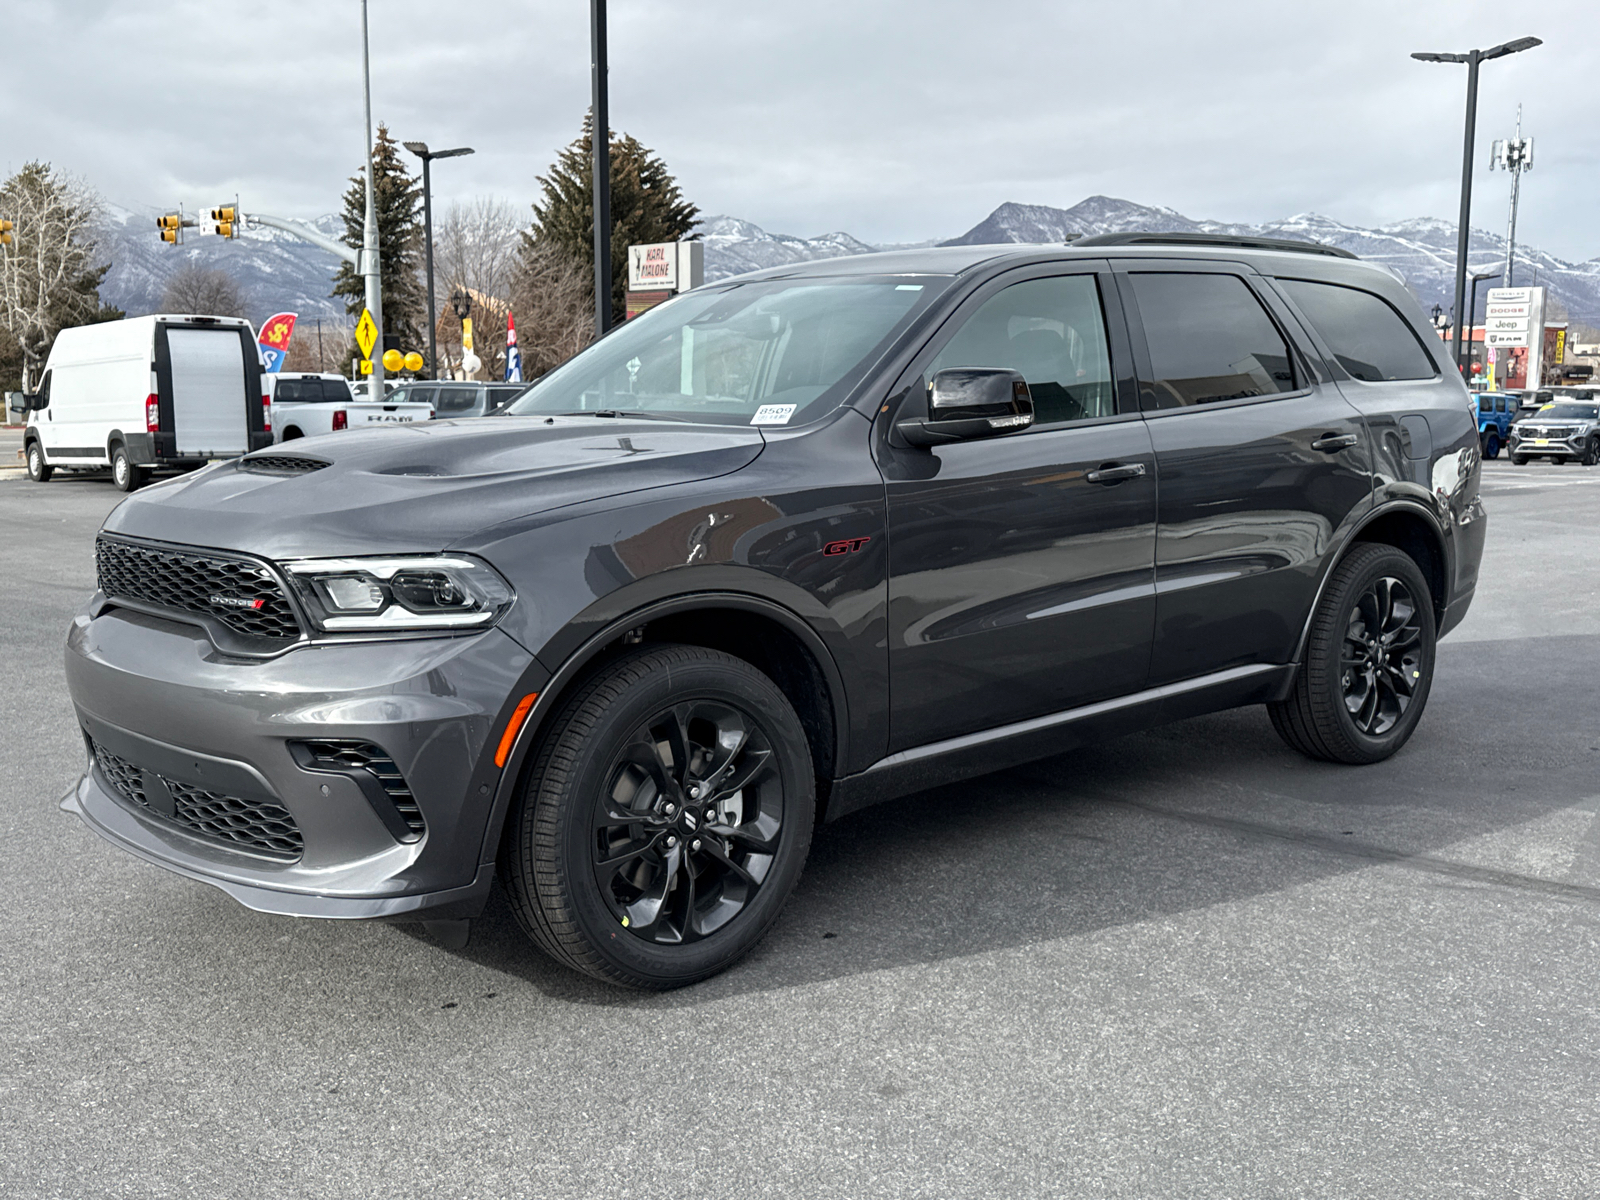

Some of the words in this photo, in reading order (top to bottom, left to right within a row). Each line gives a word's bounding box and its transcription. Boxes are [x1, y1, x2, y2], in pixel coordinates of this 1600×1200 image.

[646, 247, 665, 262] KARL
[641, 262, 669, 278] MALONE
[1495, 320, 1517, 329] Jeep
[759, 407, 792, 415] 8509
[367, 415, 413, 423] RAM
[823, 536, 871, 556] GT
[210, 596, 257, 607] DODGE
